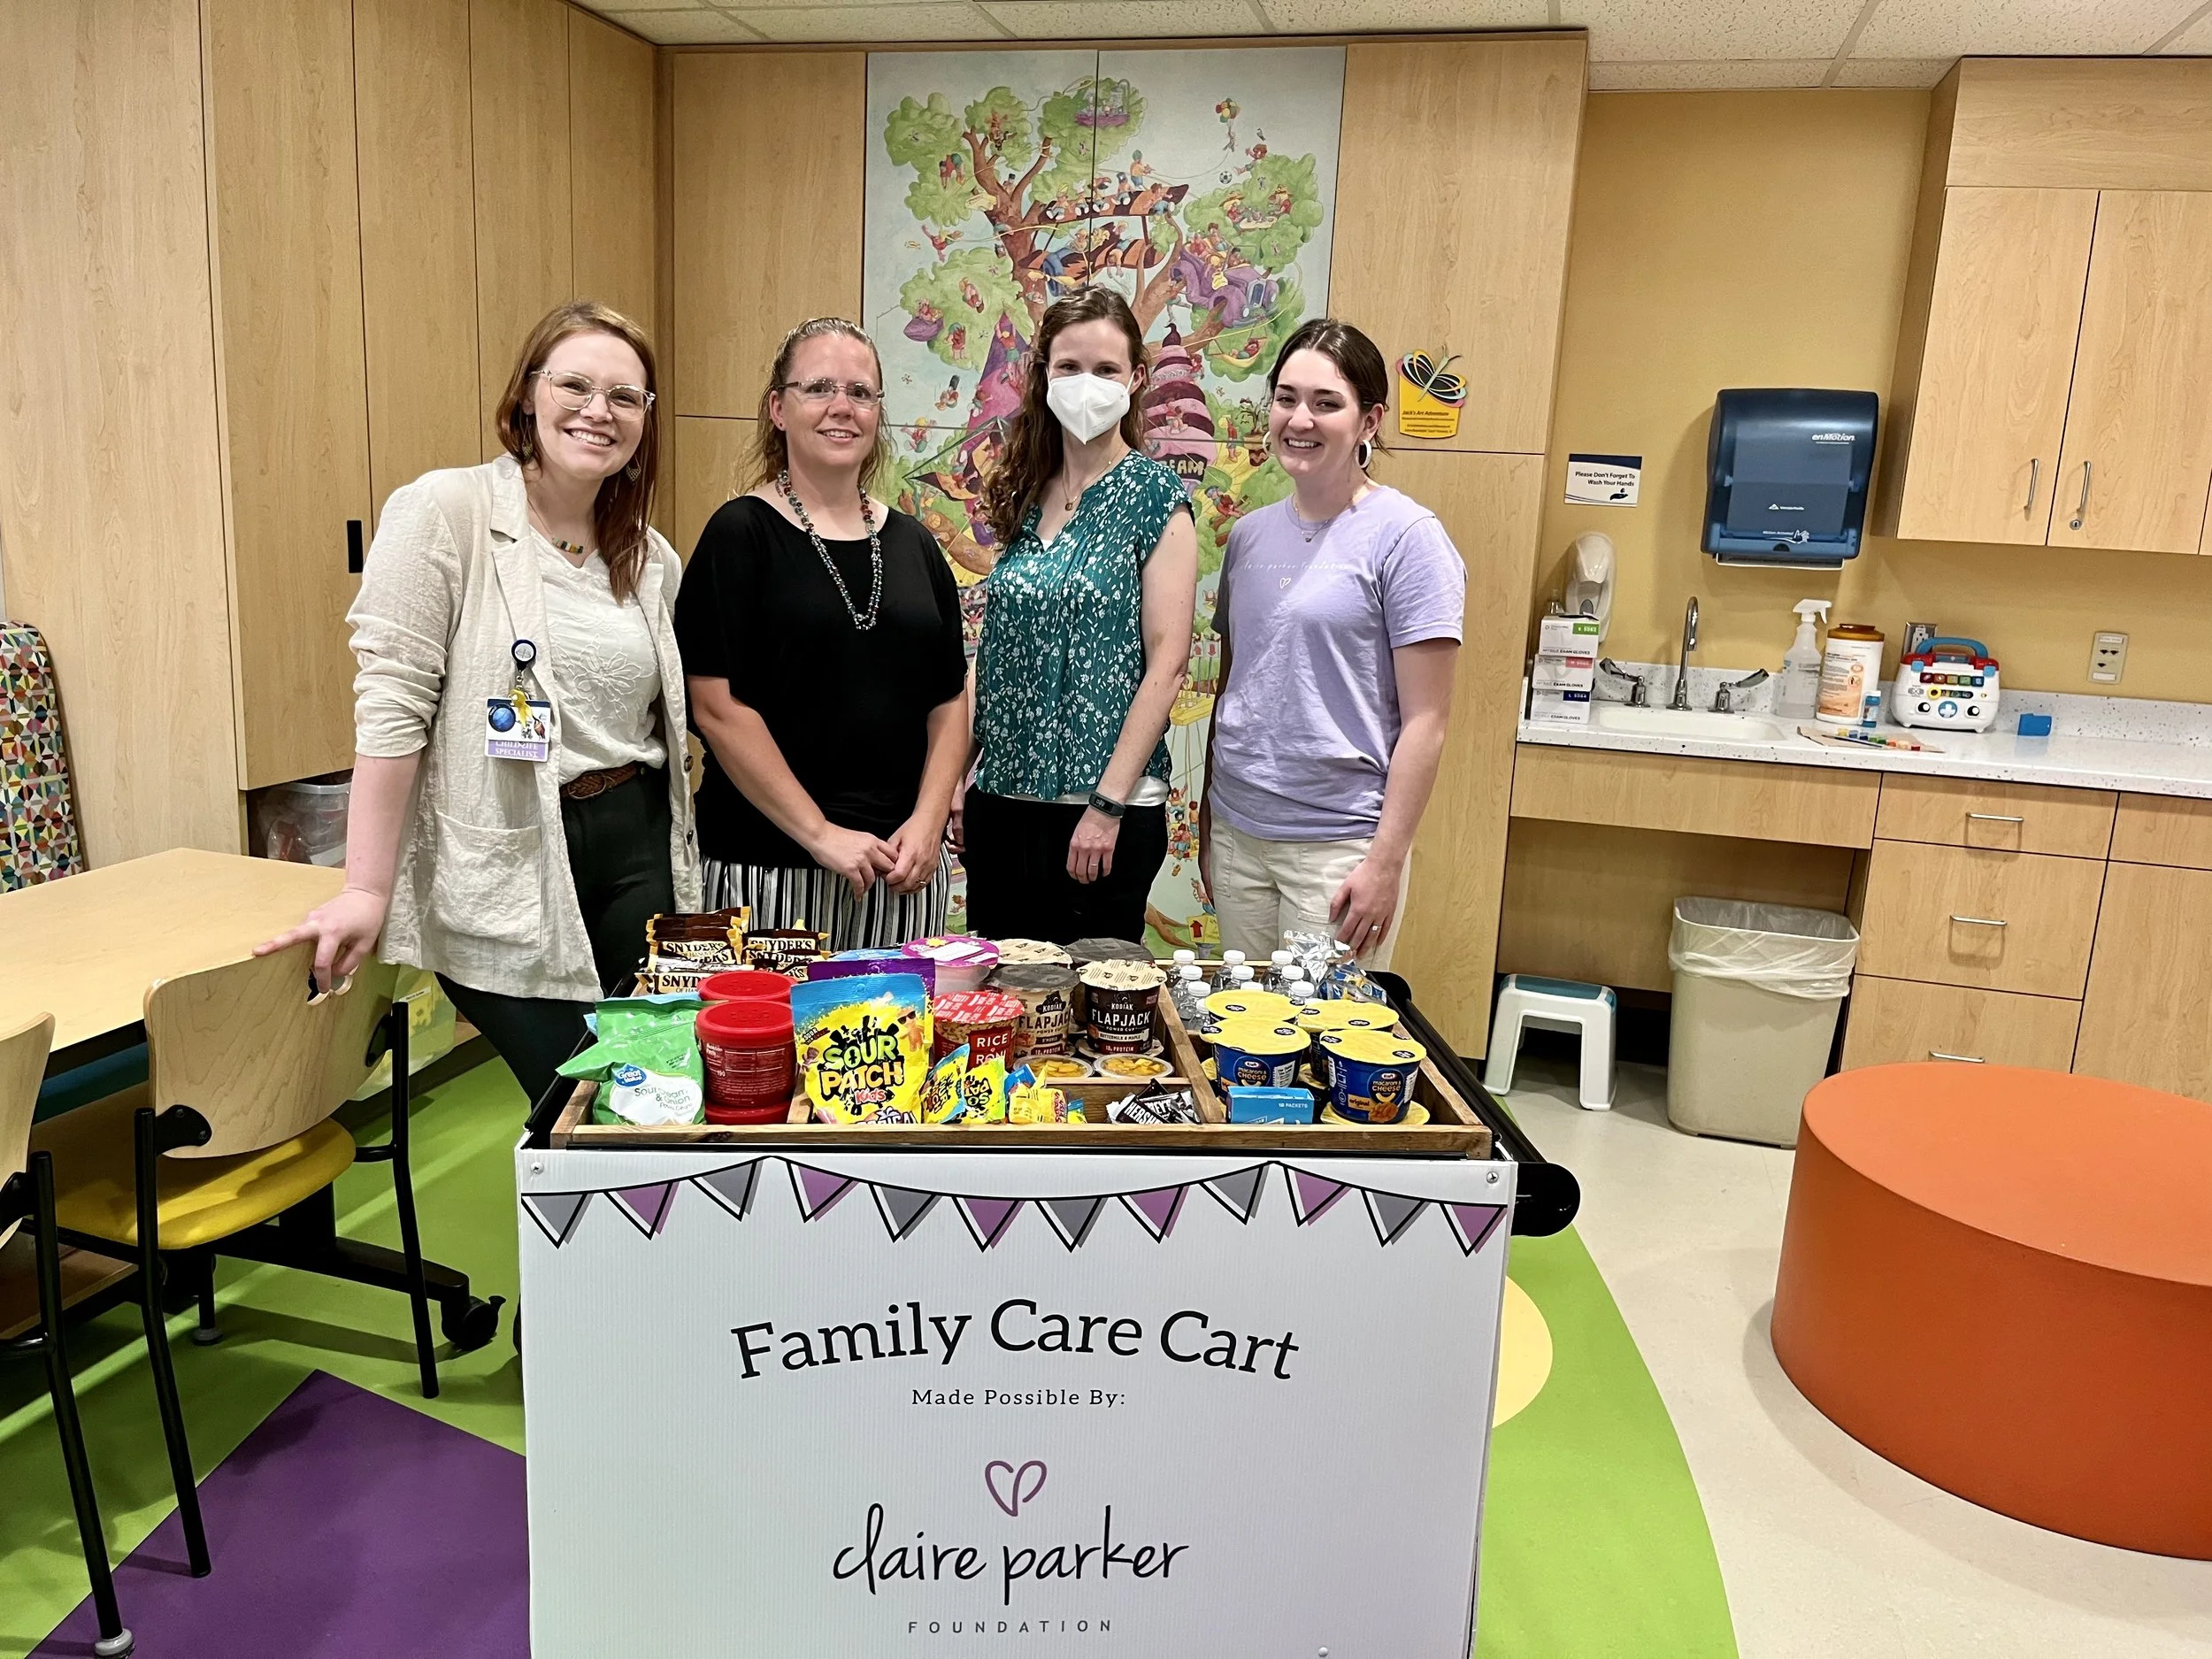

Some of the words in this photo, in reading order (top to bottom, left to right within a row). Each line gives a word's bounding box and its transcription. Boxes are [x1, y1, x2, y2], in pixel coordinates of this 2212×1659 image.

[495, 749, 538, 758] SPECIALIST
[662, 975, 702, 987] SNYD
[1092, 1010, 1151, 1026] FLAPJACK
[977, 1033, 1008, 1048] RICE
[824, 1034, 898, 1070] SOUR
[821, 1062, 904, 1096] PATCH
[634, 1087, 657, 1096] Sour
[855, 1089, 886, 1105] Kids
[731, 1302, 972, 1379] Family
[991, 1299, 1142, 1356] Care
[1160, 1310, 1299, 1379] Cart
[912, 1390, 974, 1404] Made
[985, 1389, 1079, 1405] Possible
[1090, 1390, 1125, 1408] By:
[833, 1503, 987, 1595] claire
[1003, 1505, 1189, 1606] parker
[909, 1620, 1111, 1633] FOUNDATION
